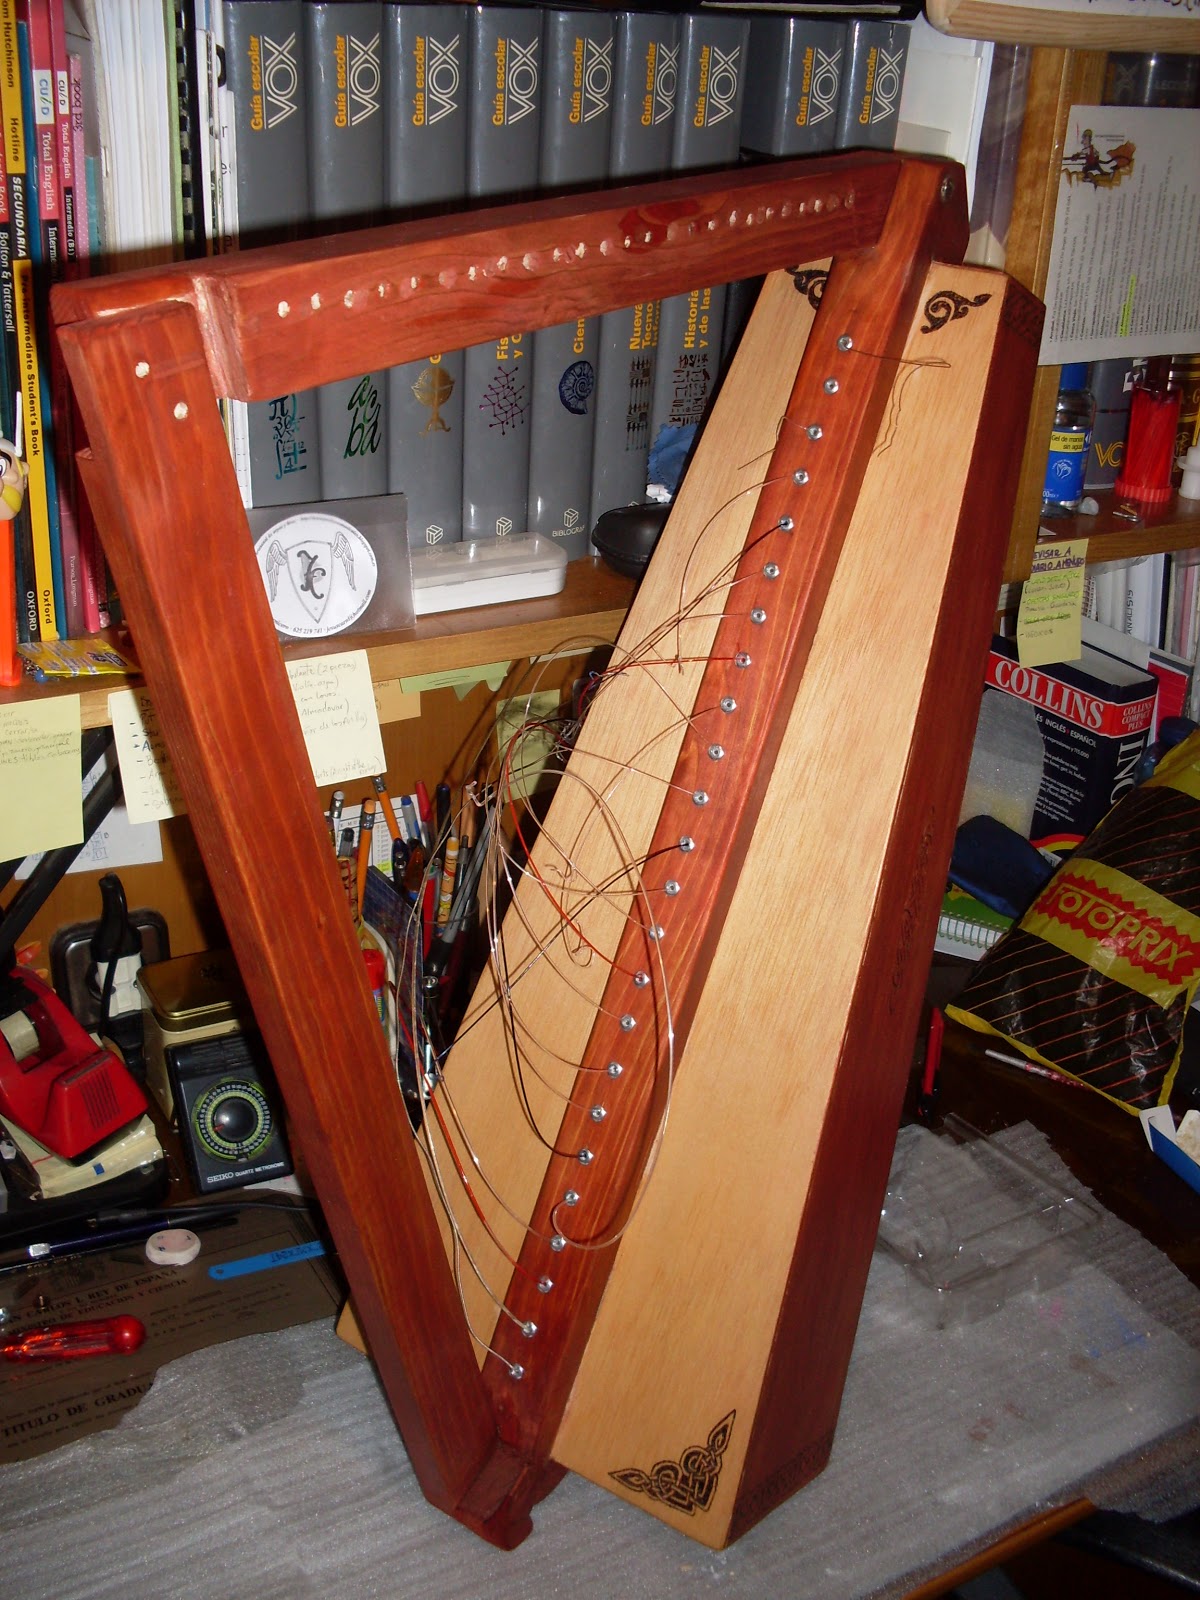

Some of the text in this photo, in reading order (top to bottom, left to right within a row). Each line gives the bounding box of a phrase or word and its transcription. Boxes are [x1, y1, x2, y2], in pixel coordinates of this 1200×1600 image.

[3, 22, 14, 88] Hutchinson
[248, 35, 263, 131] Guía escolar
[264, 32, 298, 129] VOX
[333, 35, 347, 127] Guía escolar
[350, 32, 381, 126] VOX
[412, 36, 425, 126] Guía escolar
[428, 34, 460, 125] VOX
[492, 38, 507, 126] Guía escolar
[508, 36, 539, 126] VOX
[569, 37, 584, 123] Guía escolar
[584, 36, 614, 123] VOX
[641, 41, 656, 126] Guía escolar
[654, 42, 681, 125] VOX
[694, 45, 710, 128] Guía escolar
[708, 46, 741, 127] VOX
[796, 47, 813, 126] Guía escolar
[810, 48, 842, 126] VOX
[858, 47, 877, 124] Guía escolar
[871, 48, 904, 124] VOX
[73, 78, 83, 132] 3rd book
[10, 118, 20, 162] Hotline
[42, 131, 55, 211] Total English
[62, 122, 73, 179] Total English
[12, 176, 27, 257] SECUNDARIA
[65, 194, 75, 256] Intermedio (B1)
[0, 231, 16, 332] Bolton & Tattersall
[496, 336, 509, 360] Fís
[573, 317, 585, 354] Cien
[641, 302, 653, 349] Tecno
[683, 290, 699, 348] Historia
[699, 287, 711, 348] y de las
[513, 350, 523, 359] y
[27, 373, 37, 427] Student's
[31, 429, 41, 456] Book
[1061, 435, 1068, 443] de
[552, 525, 586, 538] BIBLOGRAF
[1034, 546, 1072, 560] EVISAR A
[26, 590, 37, 631] OXFORD
[43, 589, 52, 624] Oxford
[995, 661, 1104, 729] COLLINS
[1121, 710, 1151, 725] COMPACT
[1123, 702, 1152, 716] COLLINS
[1128, 720, 1144, 731] PLUS
[1035, 713, 1097, 749] ÉS INGLÉS ESPAÑOL
[1049, 883, 1194, 972] FOTOPRIX
[207, 1161, 286, 1184] SEIKO QUARTZ METRONOME
[88, 1290, 109, 1300] REY
[117, 1284, 129, 1292] DE
[3, 1412, 60, 1437] TITULO
[66, 1403, 88, 1417] DE
